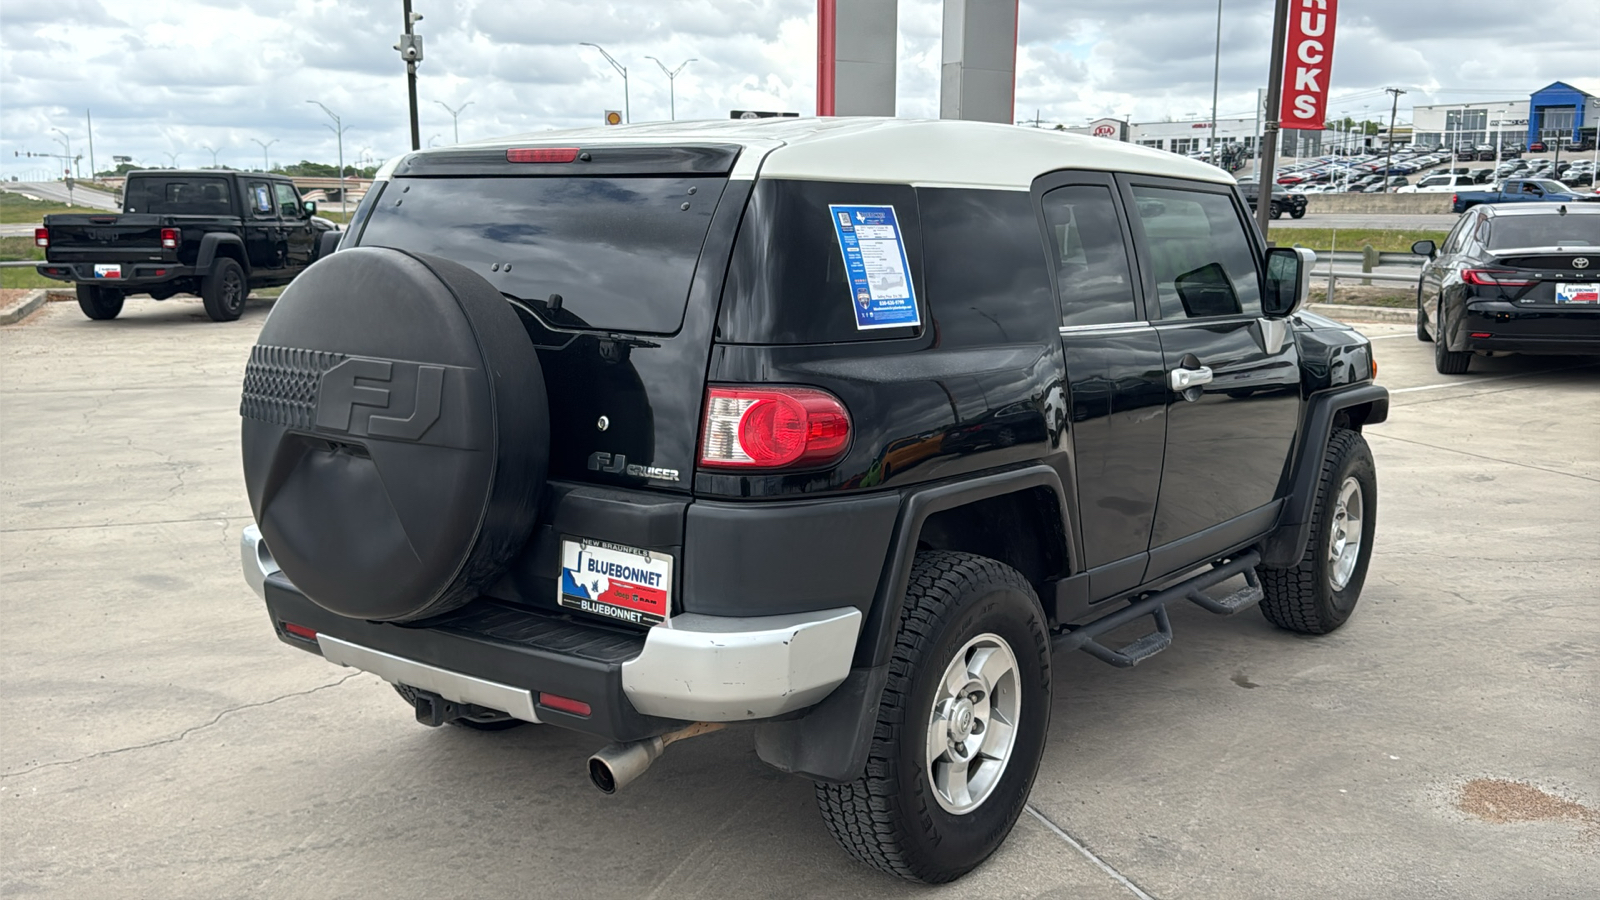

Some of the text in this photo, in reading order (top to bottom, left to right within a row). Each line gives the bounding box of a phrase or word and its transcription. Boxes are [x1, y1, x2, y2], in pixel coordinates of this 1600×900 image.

[316, 357, 445, 440] FJ
[588, 451, 680, 481] FJ CRUISER
[582, 538, 649, 558] NEW BRAUNFELS
[588, 558, 663, 588] BLUEBONNET
[614, 590, 630, 601] Jeep
[581, 600, 643, 623] BLUEBONNET
[1026, 613, 1050, 695] KELLY
